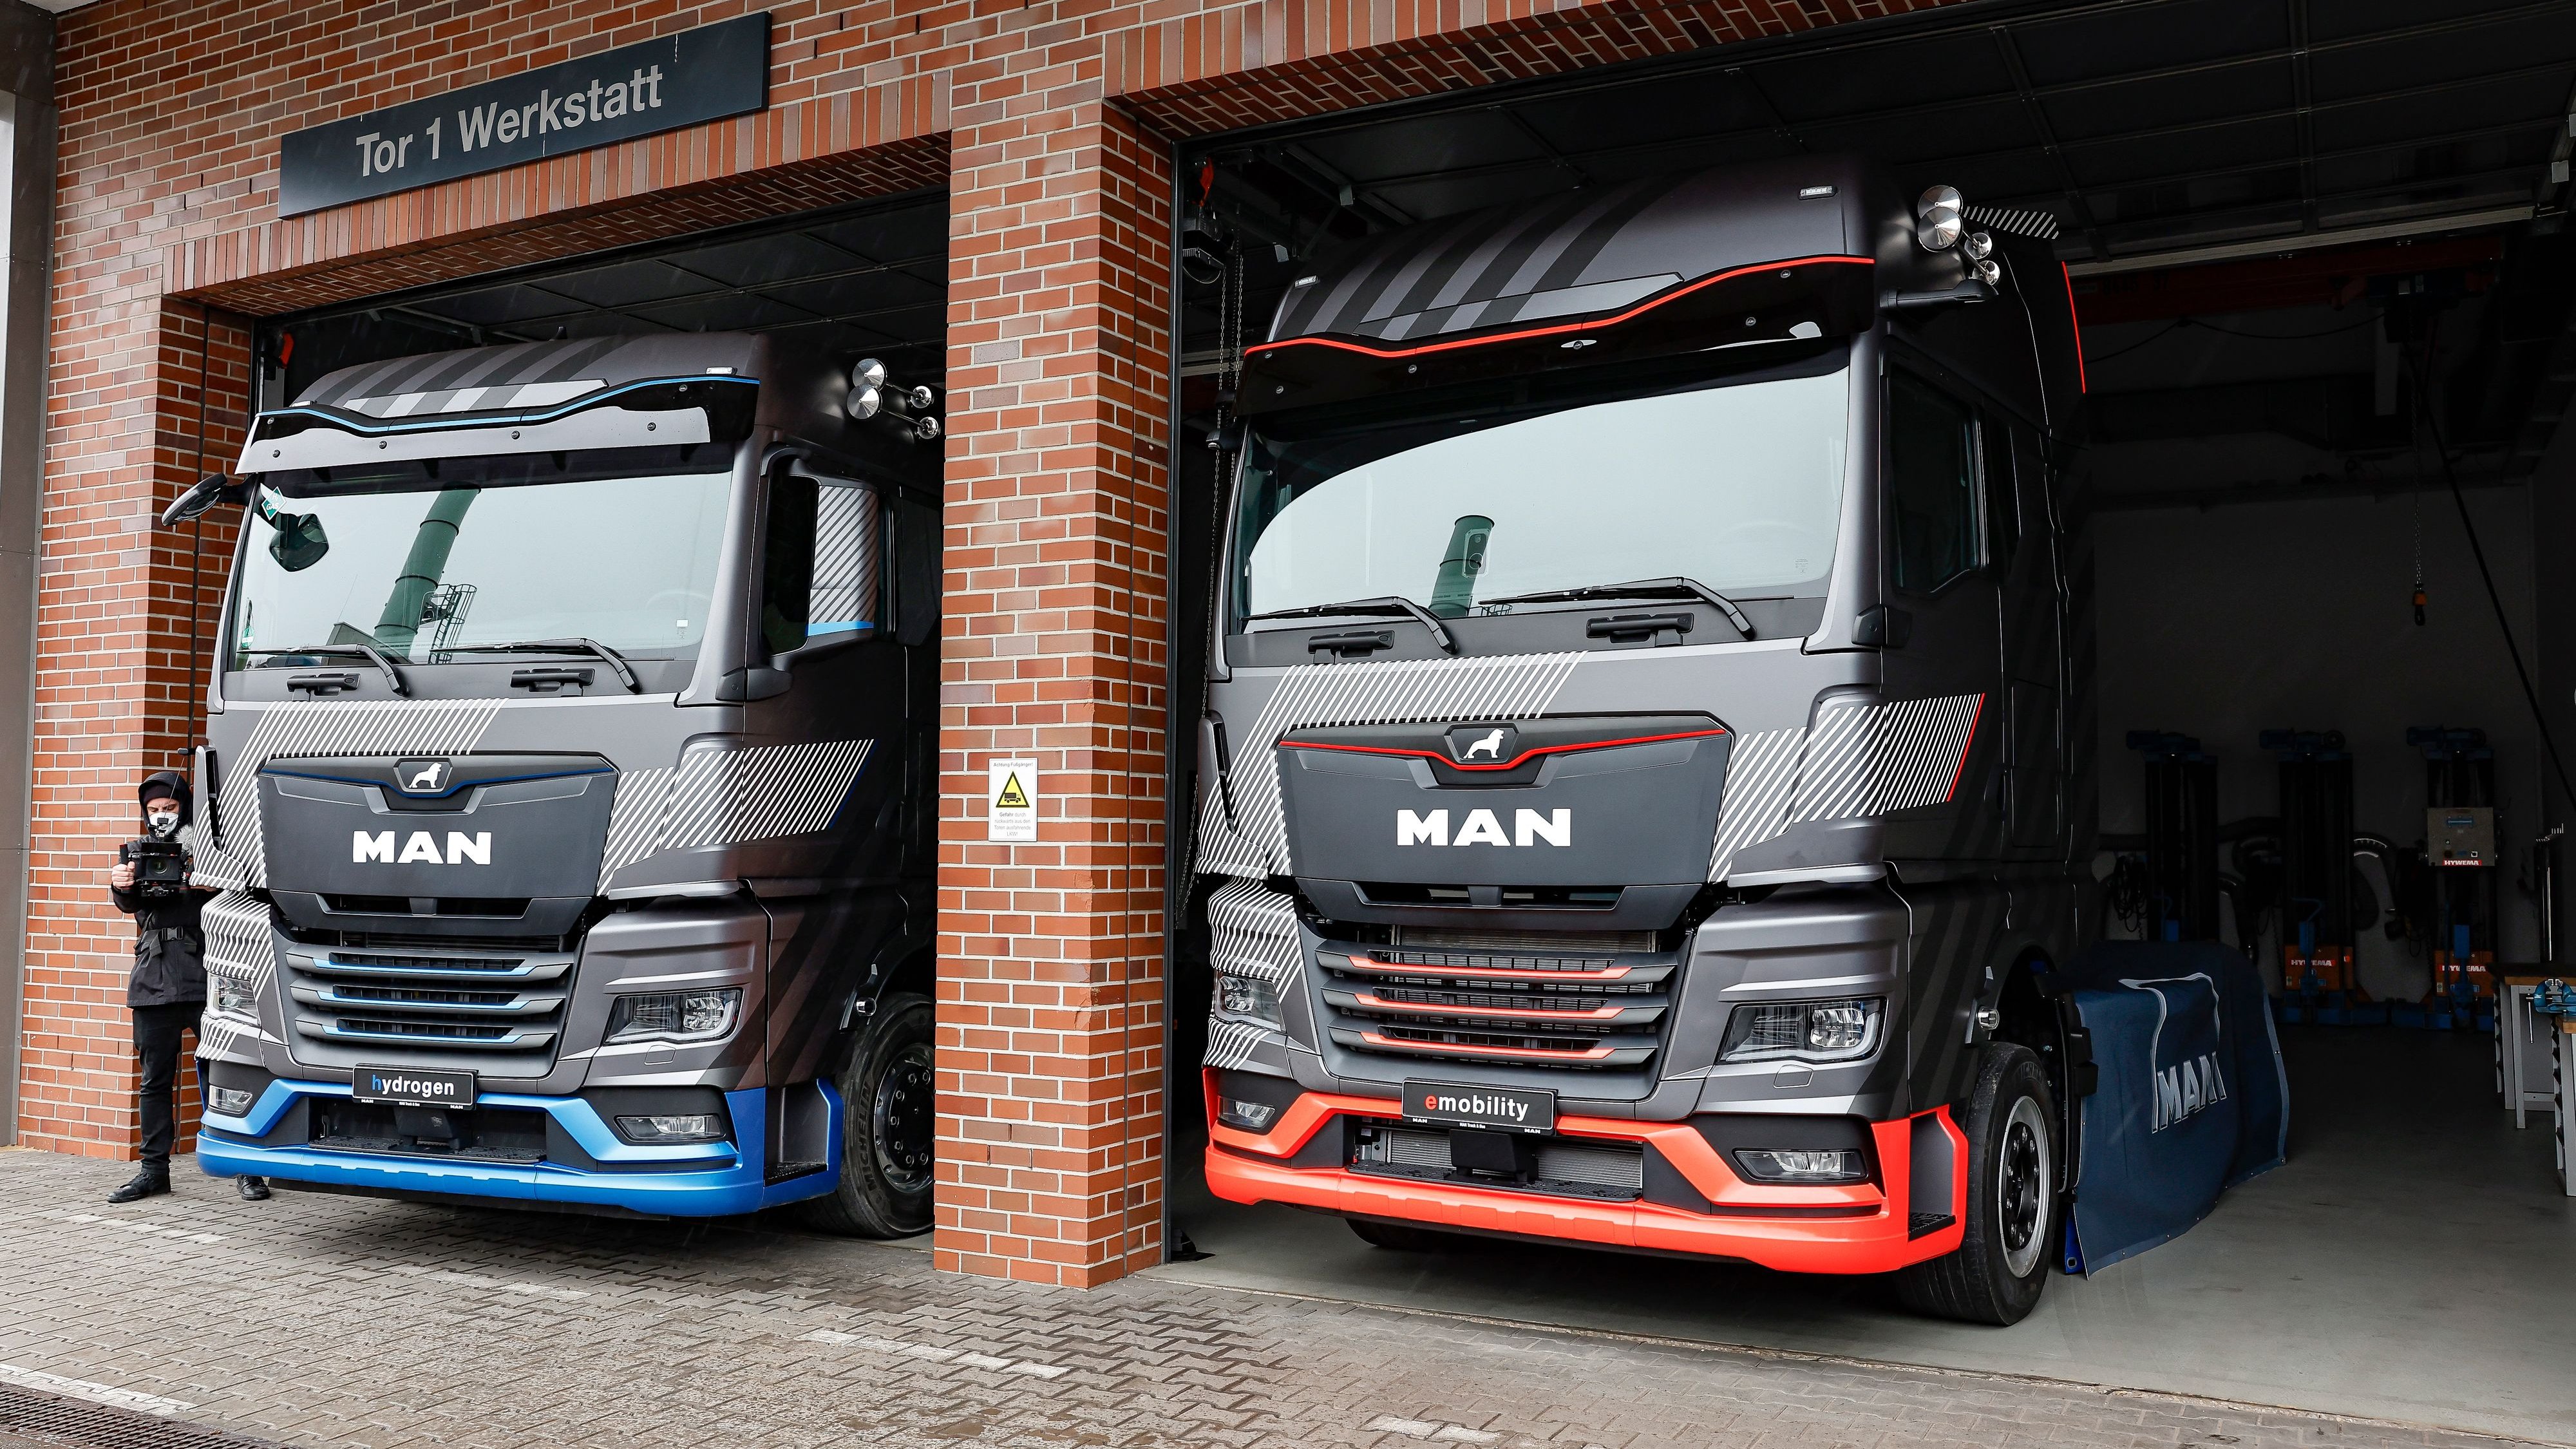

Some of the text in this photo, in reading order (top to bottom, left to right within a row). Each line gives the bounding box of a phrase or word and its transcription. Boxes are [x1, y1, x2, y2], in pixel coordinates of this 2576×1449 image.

[355, 64, 662, 177] Tor 1 Werkstatt
[1396, 808, 1571, 847] MAN
[352, 830, 492, 865] MAN
[372, 1074, 455, 1098] hydrogen
[2157, 1051, 2227, 1130] MAN
[1425, 1094, 1530, 1122] emobility
[858, 1082, 877, 1191] MICHELIN
